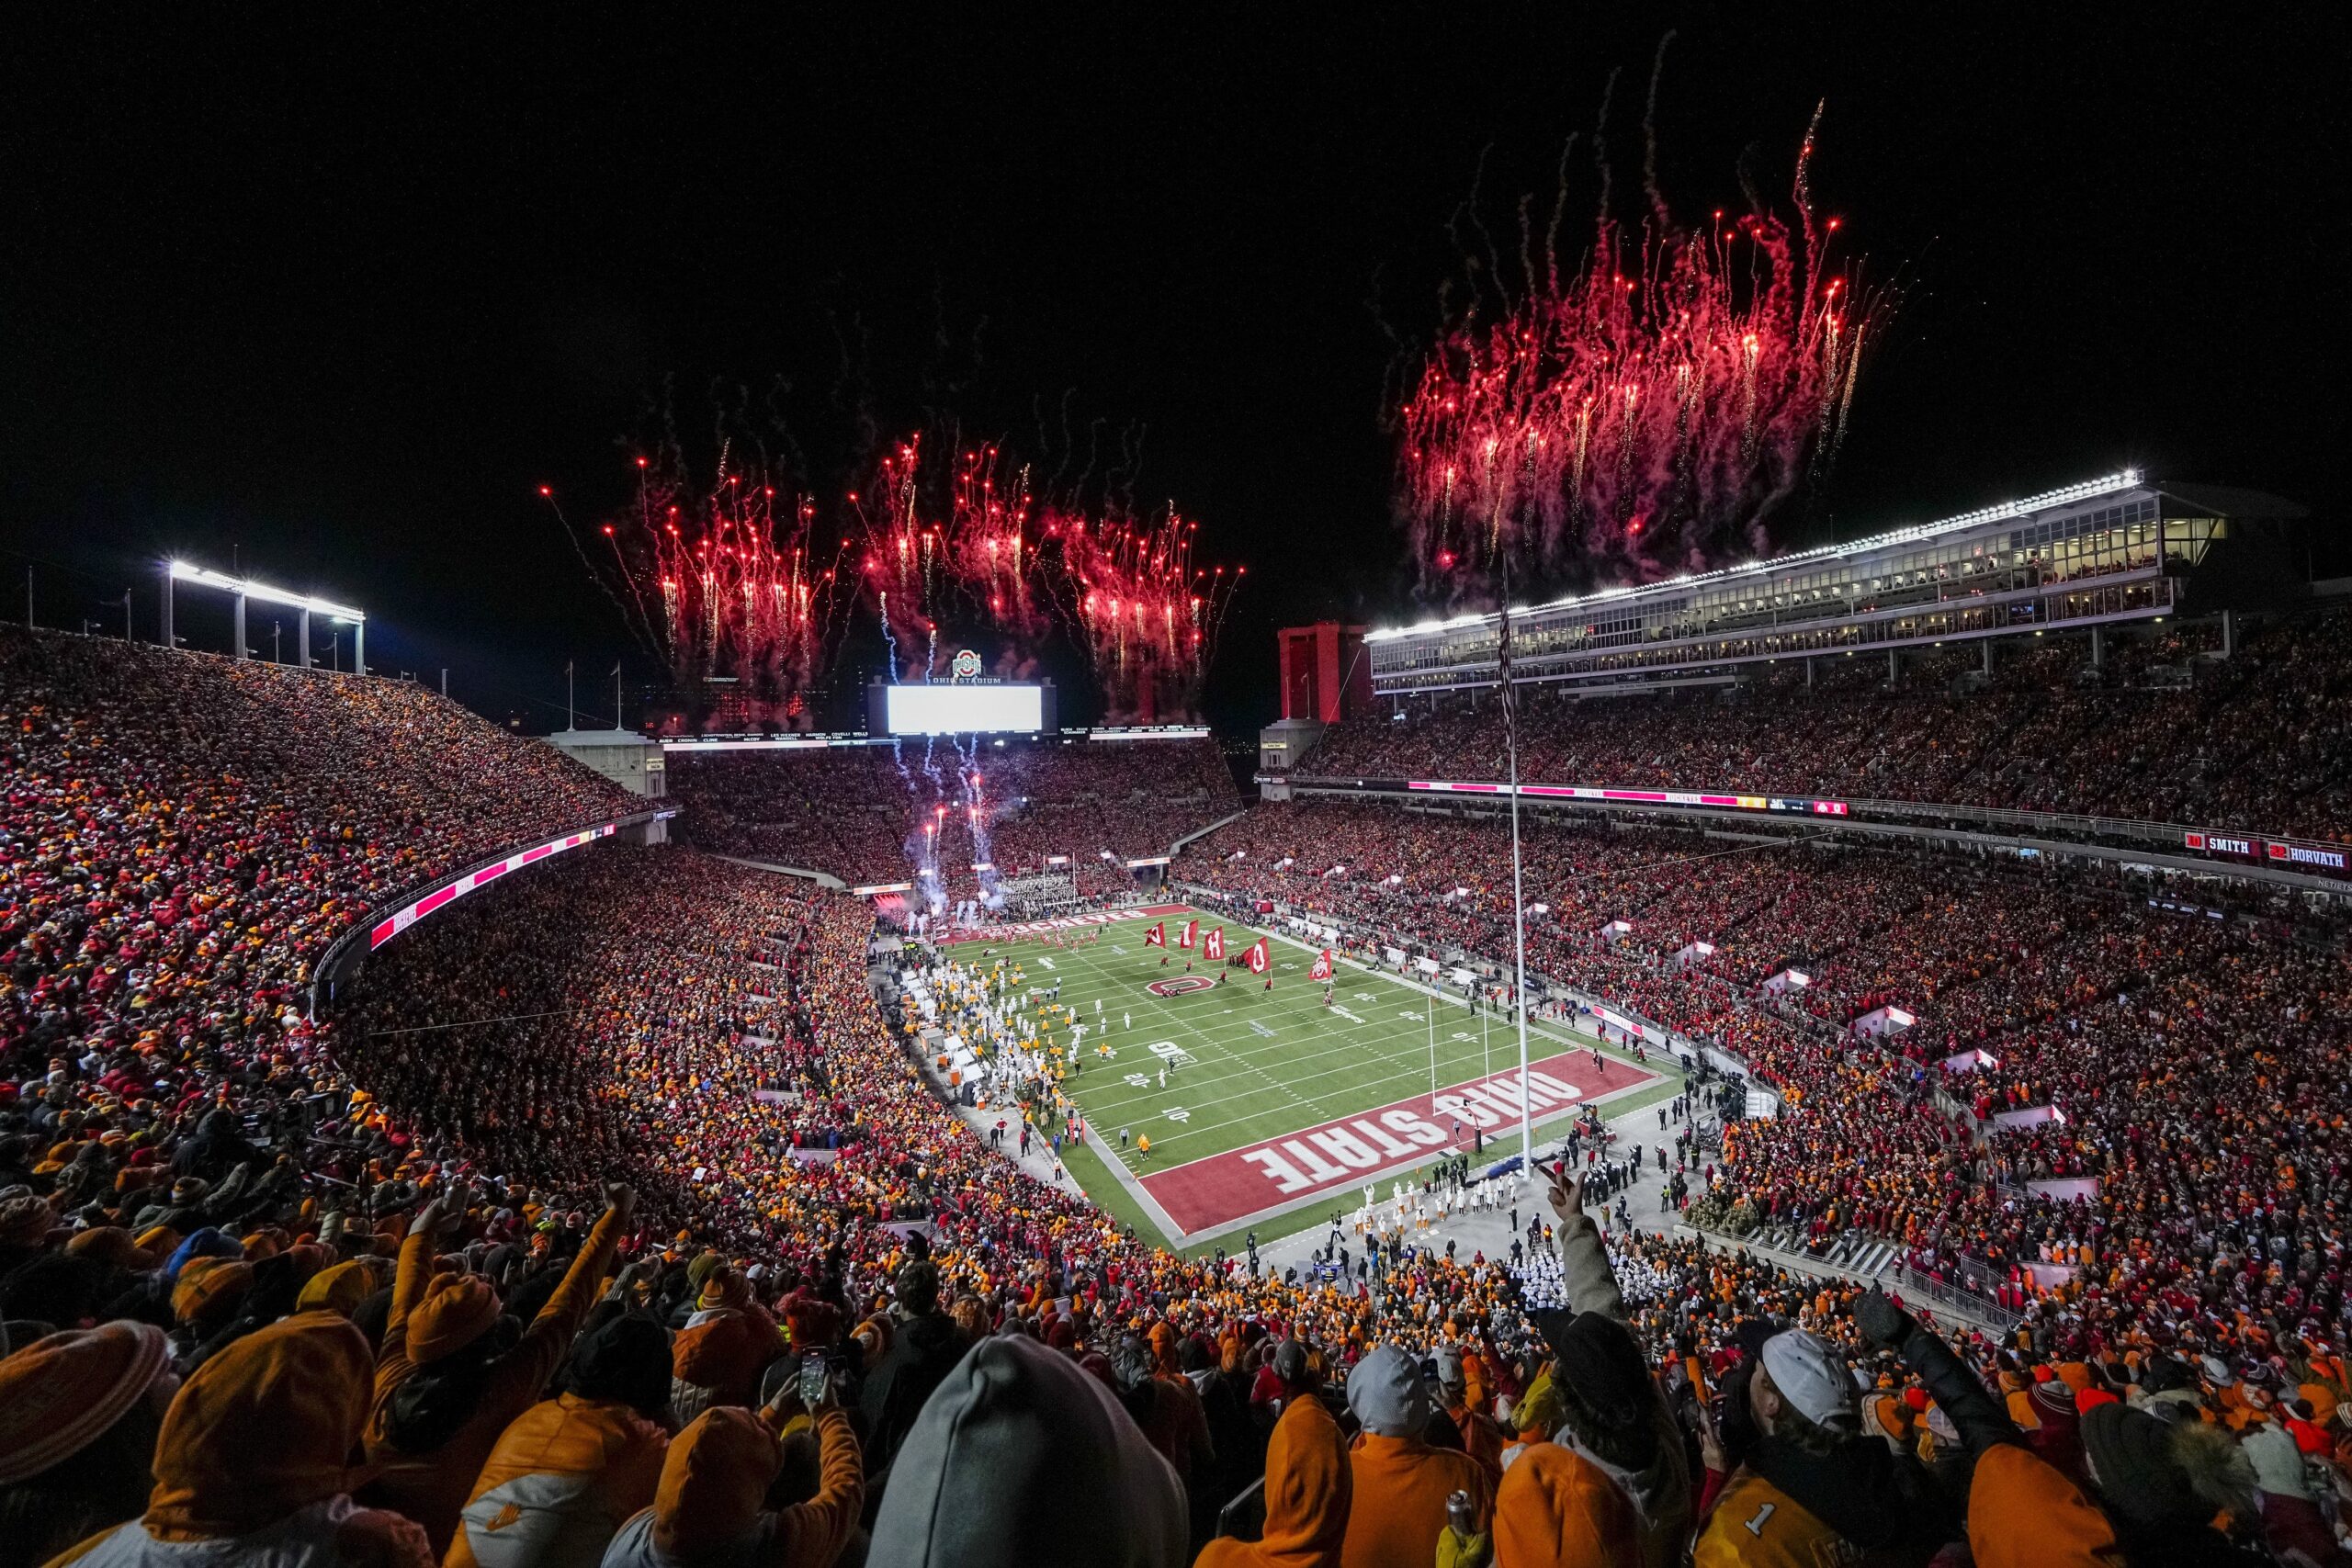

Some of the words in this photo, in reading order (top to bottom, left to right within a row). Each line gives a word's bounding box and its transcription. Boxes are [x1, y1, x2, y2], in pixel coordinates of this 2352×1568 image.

[2186, 834, 2201, 848] 10
[2210, 837, 2249, 854] SMITH
[2290, 848, 2344, 868] HORVATH
[1207, 930, 1221, 959] H
[1252, 943, 1265, 974] O
[1124, 1072, 1151, 1087] 20
[1433, 1071, 1583, 1127] OHIO
[1161, 1106, 1191, 1122] 10
[1240, 1110, 1448, 1194] STATE
[1744, 1502, 1777, 1537] 1
